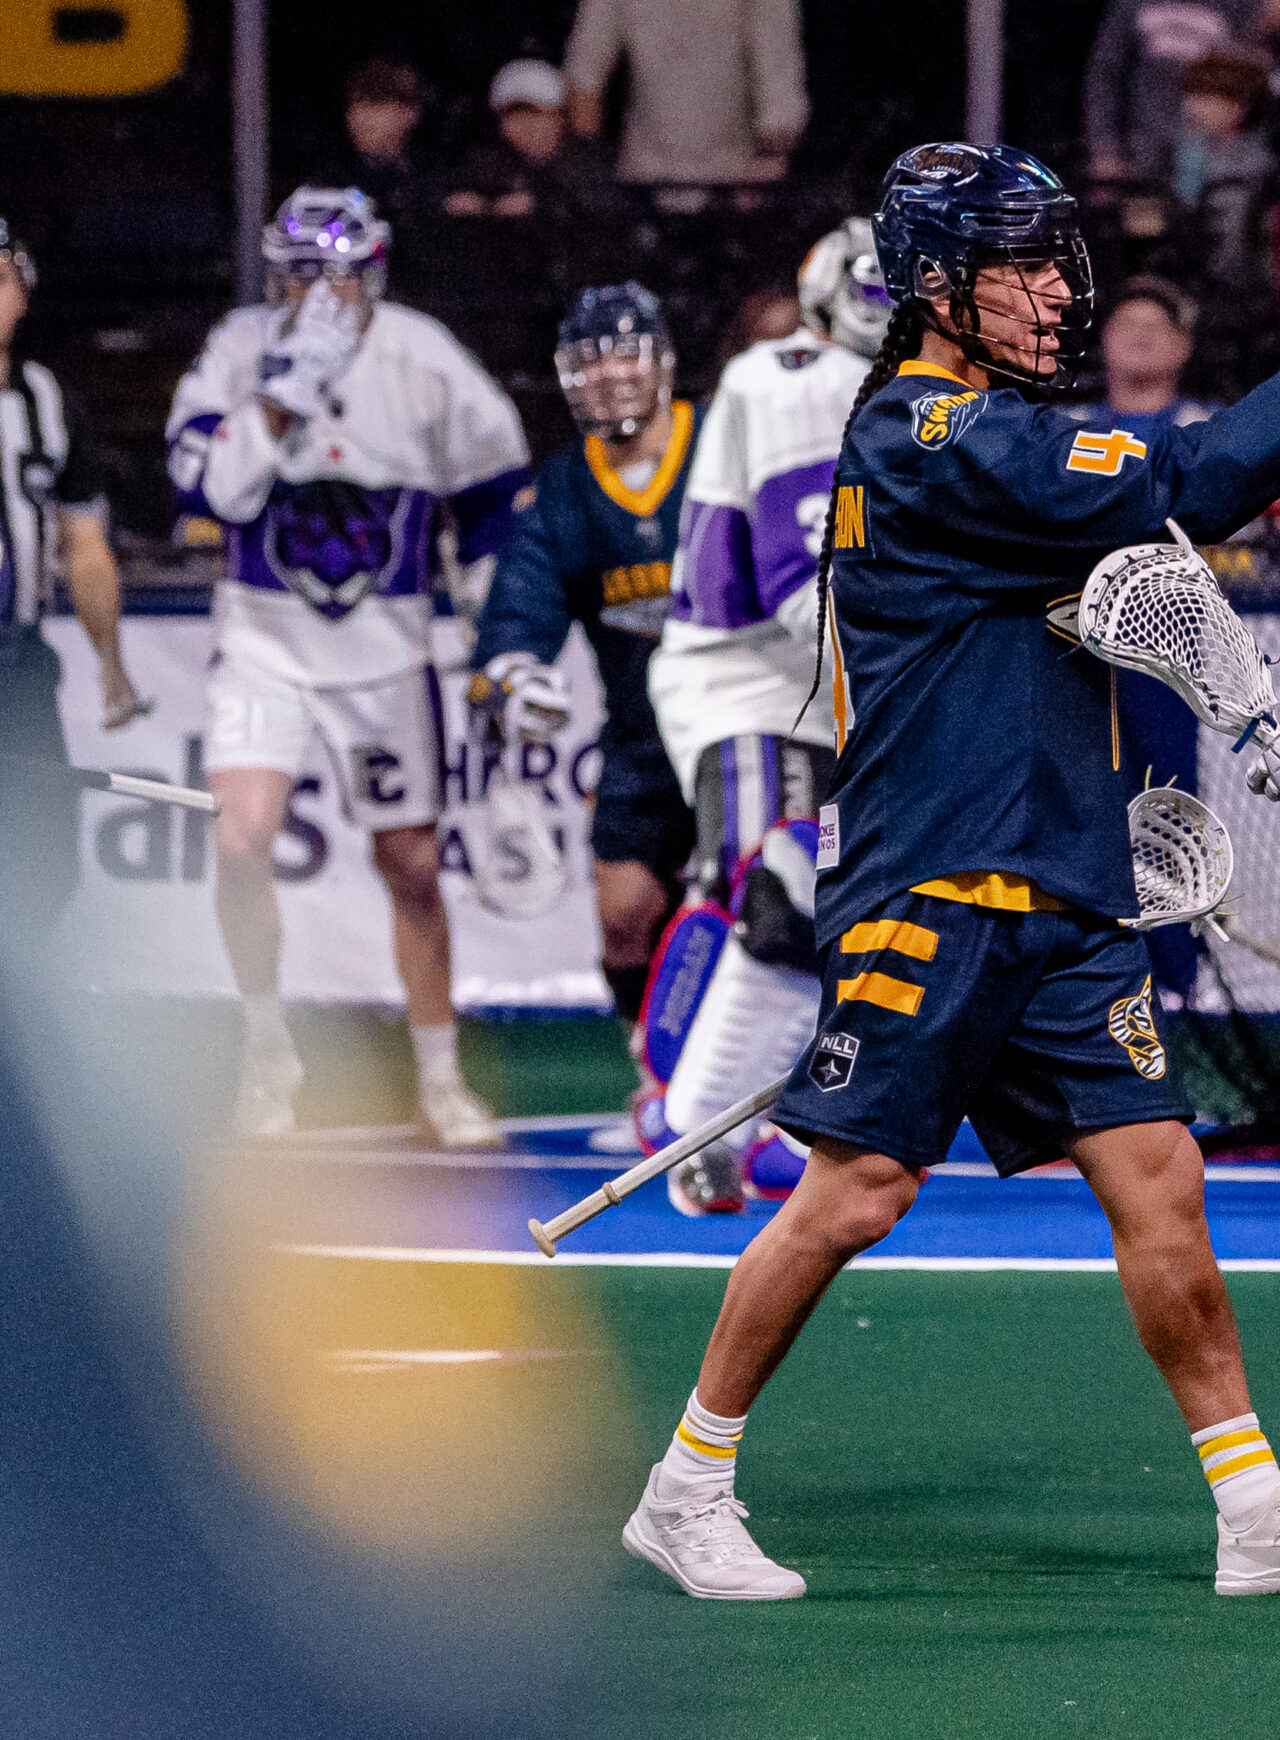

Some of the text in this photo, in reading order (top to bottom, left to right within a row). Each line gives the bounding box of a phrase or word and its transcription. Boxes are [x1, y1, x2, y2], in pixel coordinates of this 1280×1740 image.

[920, 391, 979, 442] SWARM
[1066, 429, 1147, 477] 4
[821, 1036, 854, 1054] NLL
